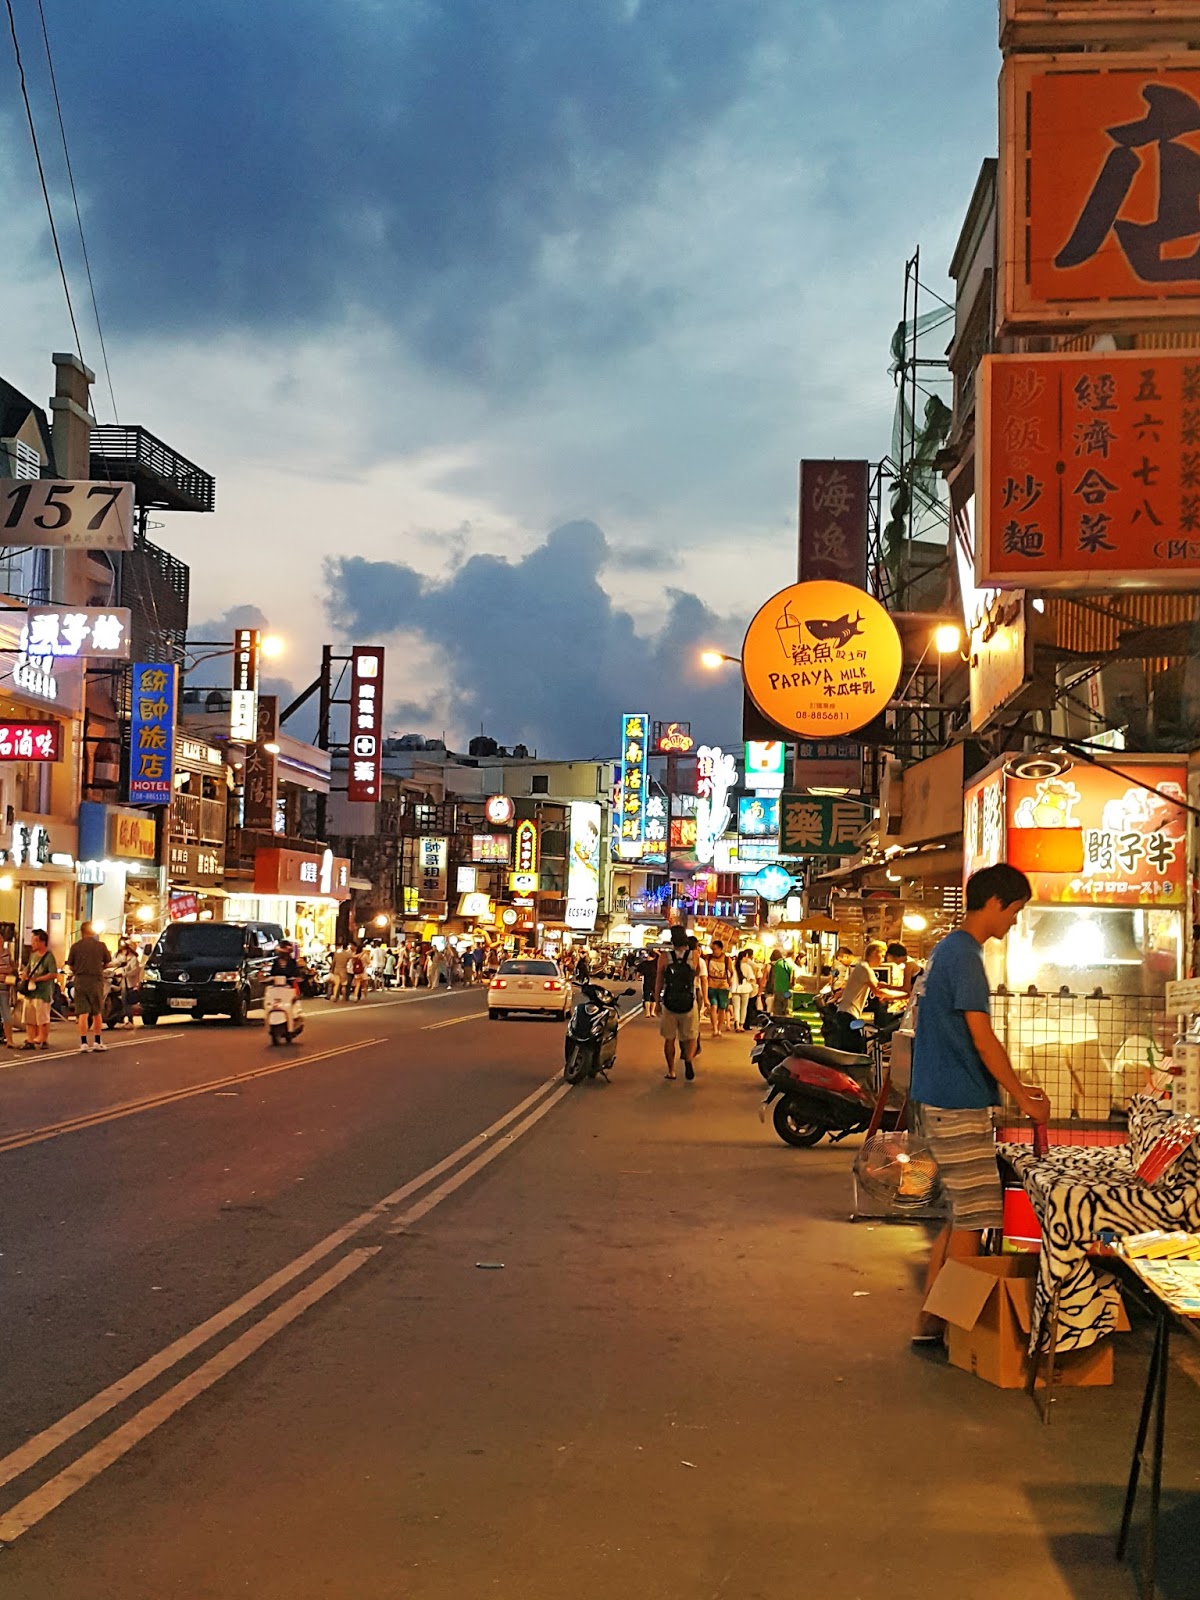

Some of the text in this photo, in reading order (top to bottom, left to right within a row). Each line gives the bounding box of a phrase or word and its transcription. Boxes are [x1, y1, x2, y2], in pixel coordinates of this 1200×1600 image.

[1073, 374, 1120, 553] 經濟合菜
[4, 484, 123, 530] 157
[768, 666, 867, 690] PAPAYA MILK
[823, 681, 876, 697] 木瓜牛乳
[138, 669, 168, 778] 統帥旅店
[796, 711, 849, 720] 08-8856811
[134, 781, 169, 791] HOTEL
[785, 803, 868, 848] 藥局
[568, 908, 595, 917] ECSTASY
